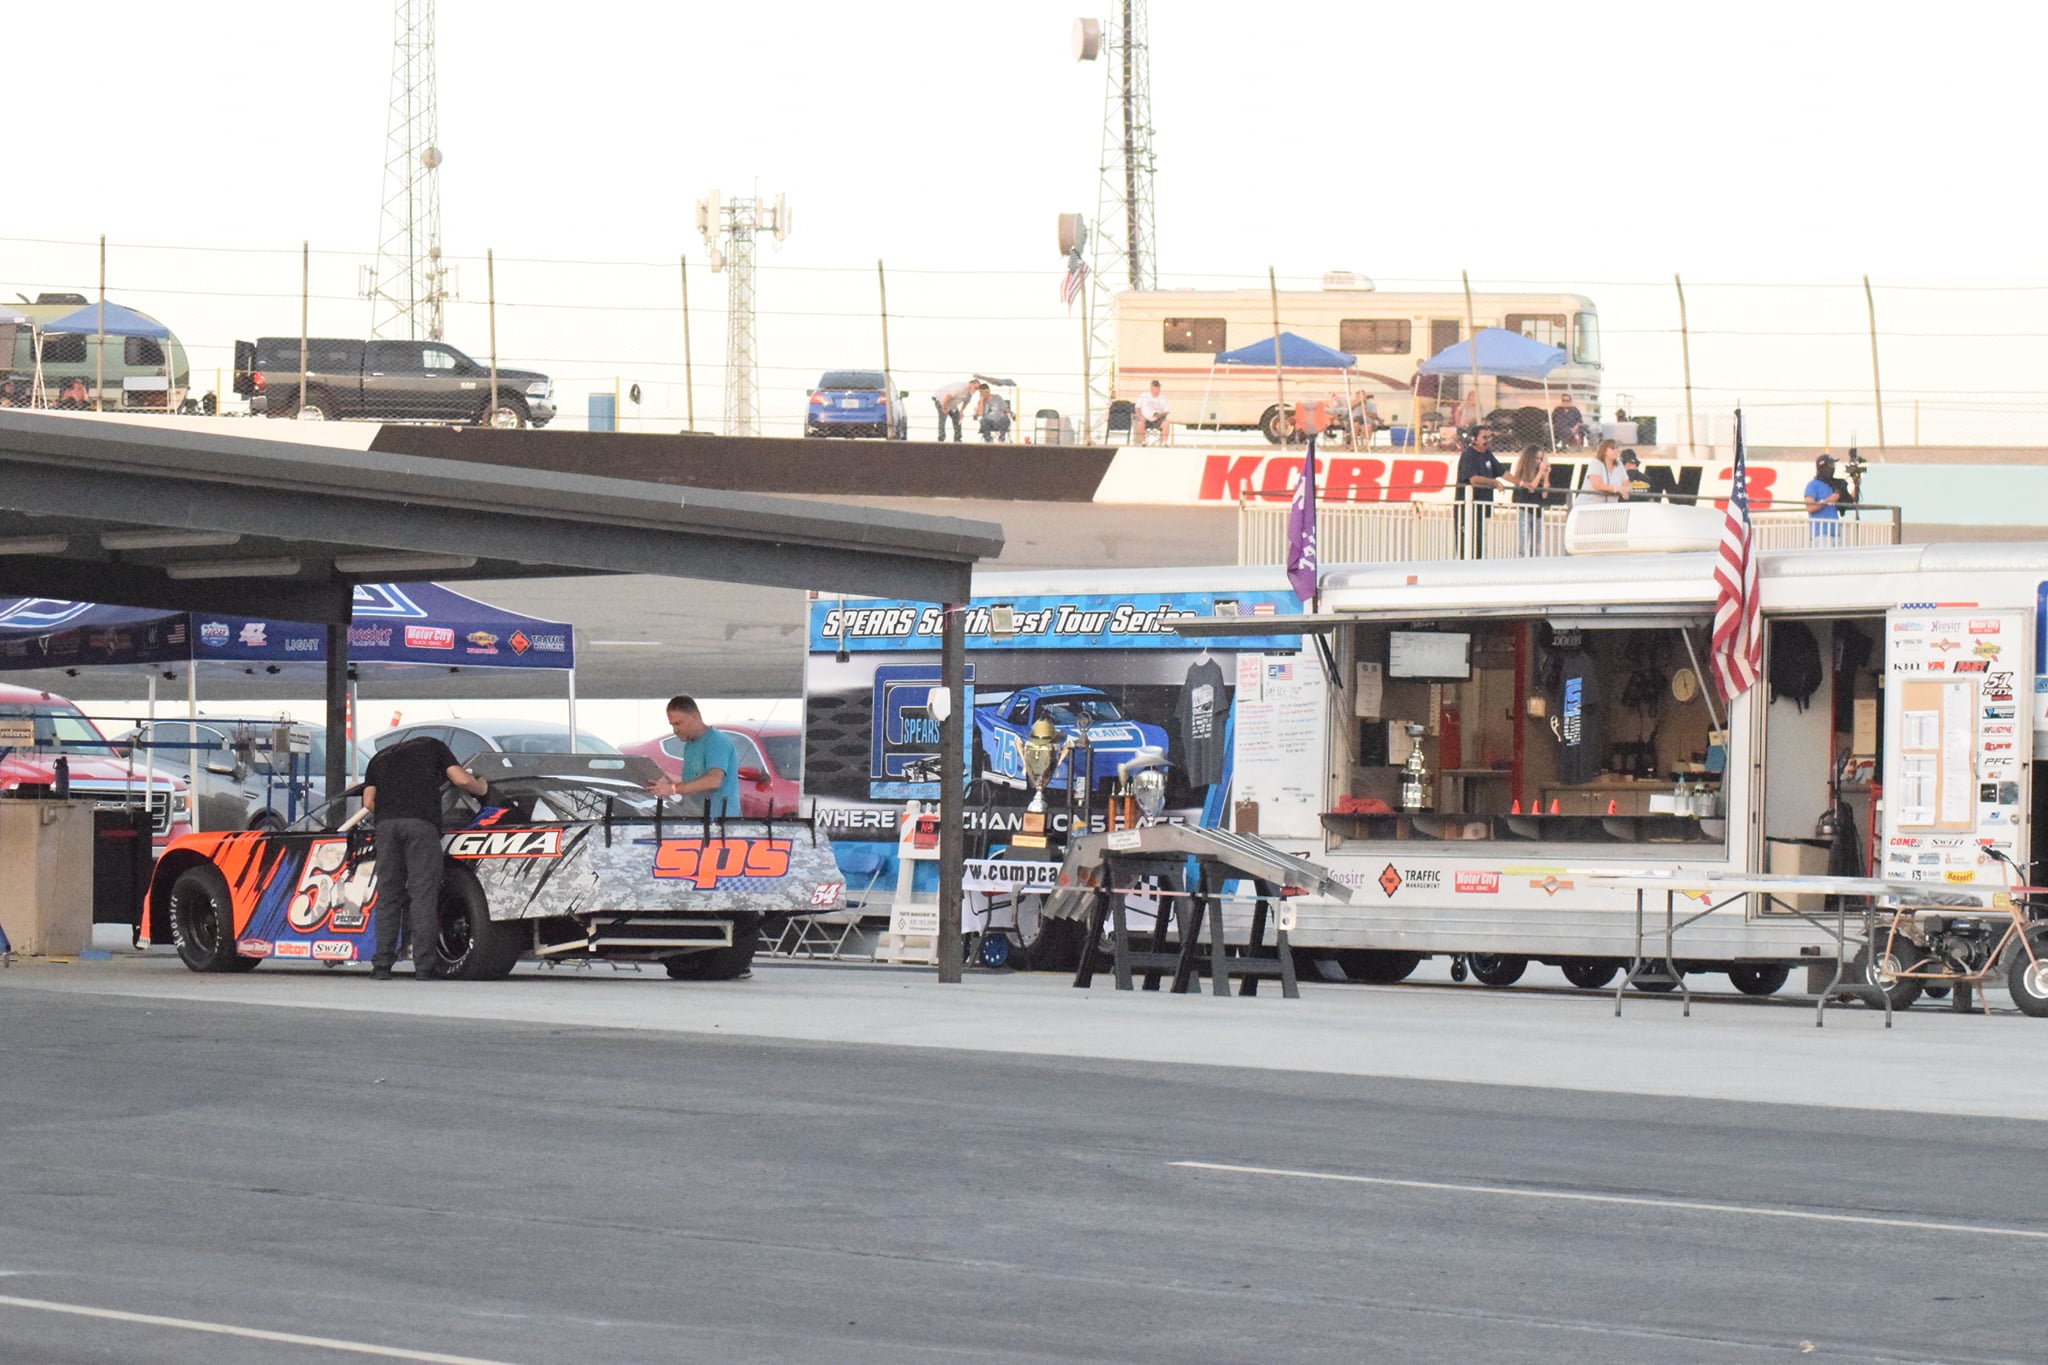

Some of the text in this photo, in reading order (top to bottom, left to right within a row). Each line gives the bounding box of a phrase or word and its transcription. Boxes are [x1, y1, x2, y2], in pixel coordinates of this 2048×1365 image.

[1198, 455, 1449, 504] KCRP
[1714, 466, 1778, 511] 3
[822, 608, 917, 638] SPEARS
[1054, 605, 1110, 635] Tour
[407, 627, 453, 644] Motor City
[531, 635, 566, 644] TRAFFIC
[285, 638, 320, 651] LIGHT
[1984, 672, 2013, 688] 51
[903, 717, 941, 746] SPEARS
[994, 726, 1018, 777] 75
[1984, 757, 2013, 765] PFC
[814, 809, 896, 828] WHERE
[289, 842, 377, 926] 54
[1405, 870, 1441, 882] TRAFFIC
[1456, 871, 1498, 888] Motor City
[810, 884, 842, 906] 54
[276, 942, 310, 956] tilton
[315, 941, 350, 953] Swift
